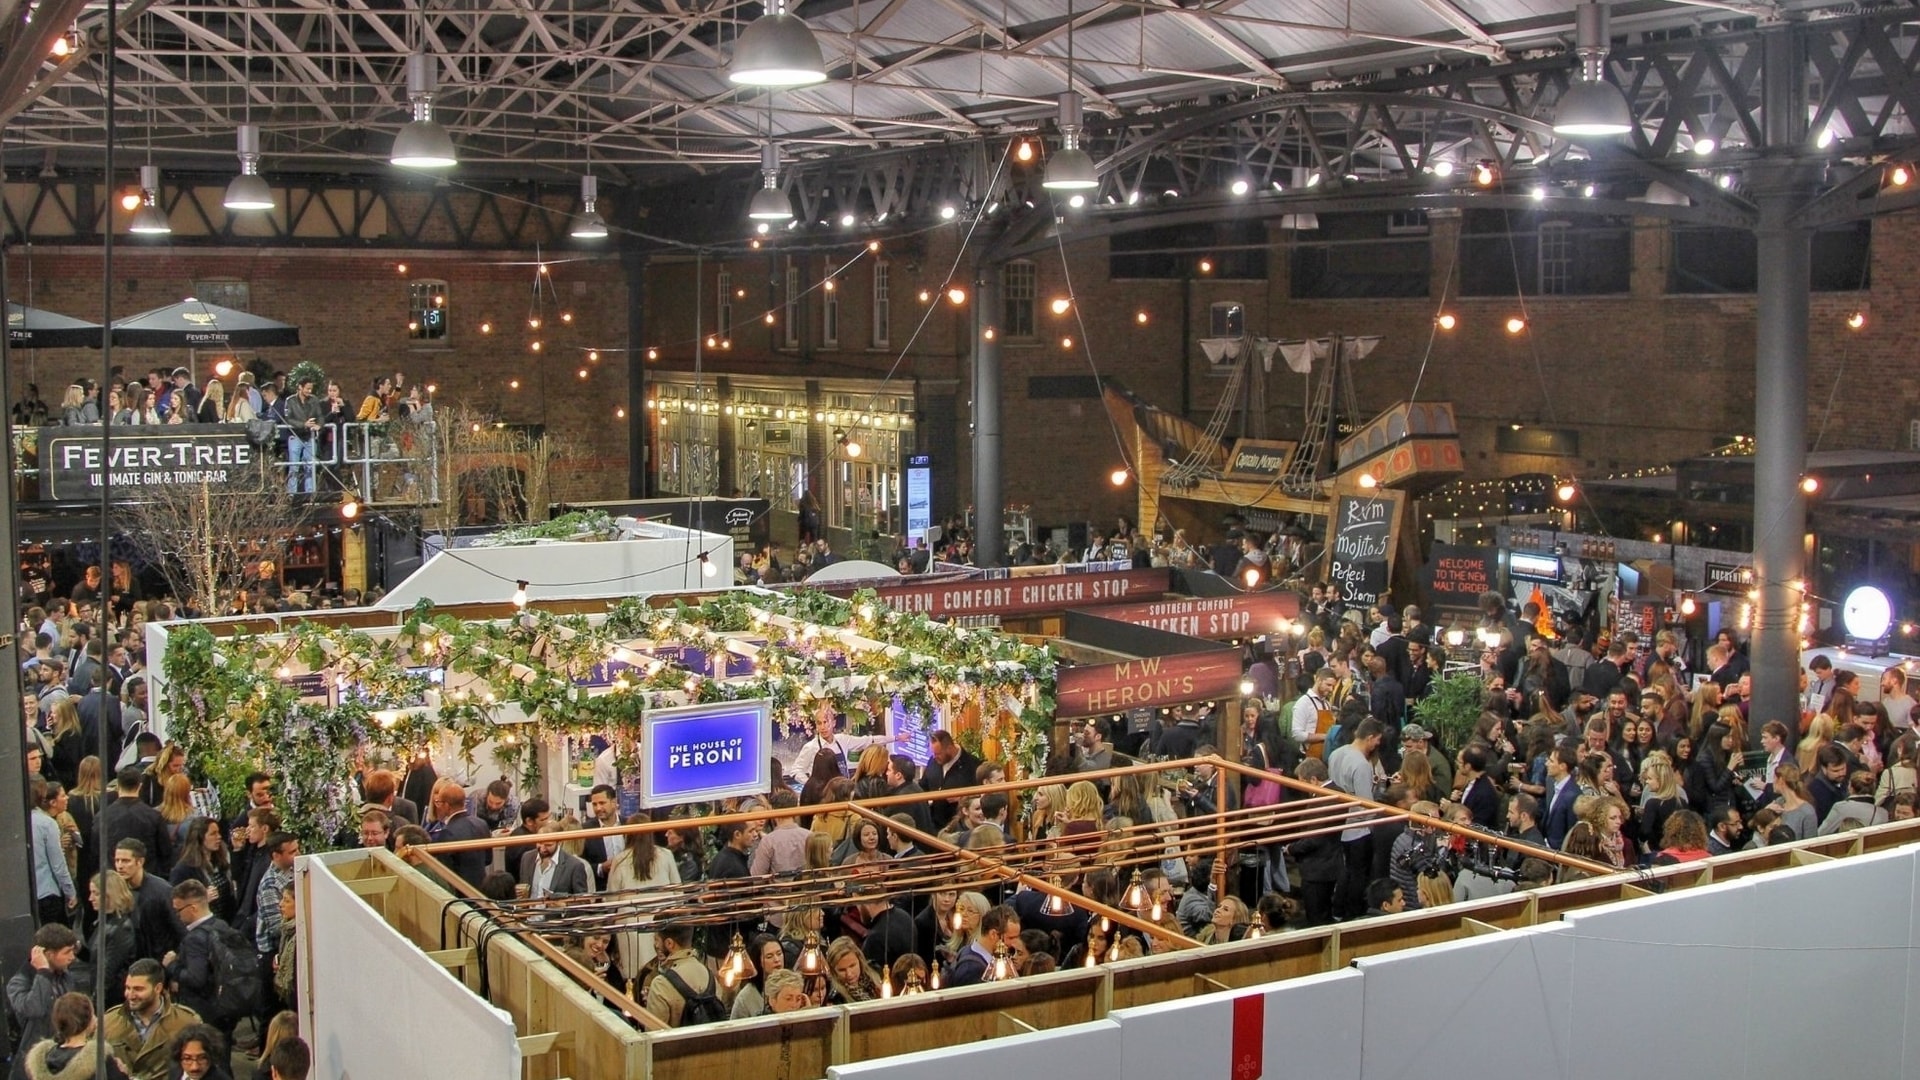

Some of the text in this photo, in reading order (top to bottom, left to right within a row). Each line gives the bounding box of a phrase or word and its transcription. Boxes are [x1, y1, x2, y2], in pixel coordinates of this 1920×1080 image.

[64, 443, 250, 469] FEVER-TREE
[91, 472, 140, 487] ULIMATE
[163, 472, 172, 484] &
[173, 470, 203, 485] TONIC
[205, 469, 228, 483] BAR
[1331, 561, 1366, 582] Perfect
[1439, 558, 1485, 570] WELCOME
[1435, 569, 1487, 582] TO THE NEW
[876, 578, 1129, 613] THERN COMFORT CHICKEN STOP
[1342, 581, 1376, 603] Storm
[1433, 581, 1489, 595] MALT ORDER
[1149, 598, 1235, 616] SOUTHERN COMFORT
[1132, 611, 1250, 636] CKEN STOP
[1115, 656, 1167, 682] M.W.
[1087, 675, 1194, 712] HERON'S
[670, 738, 742, 754] THE HOUSE OF
[669, 747, 742, 769] PERONI
